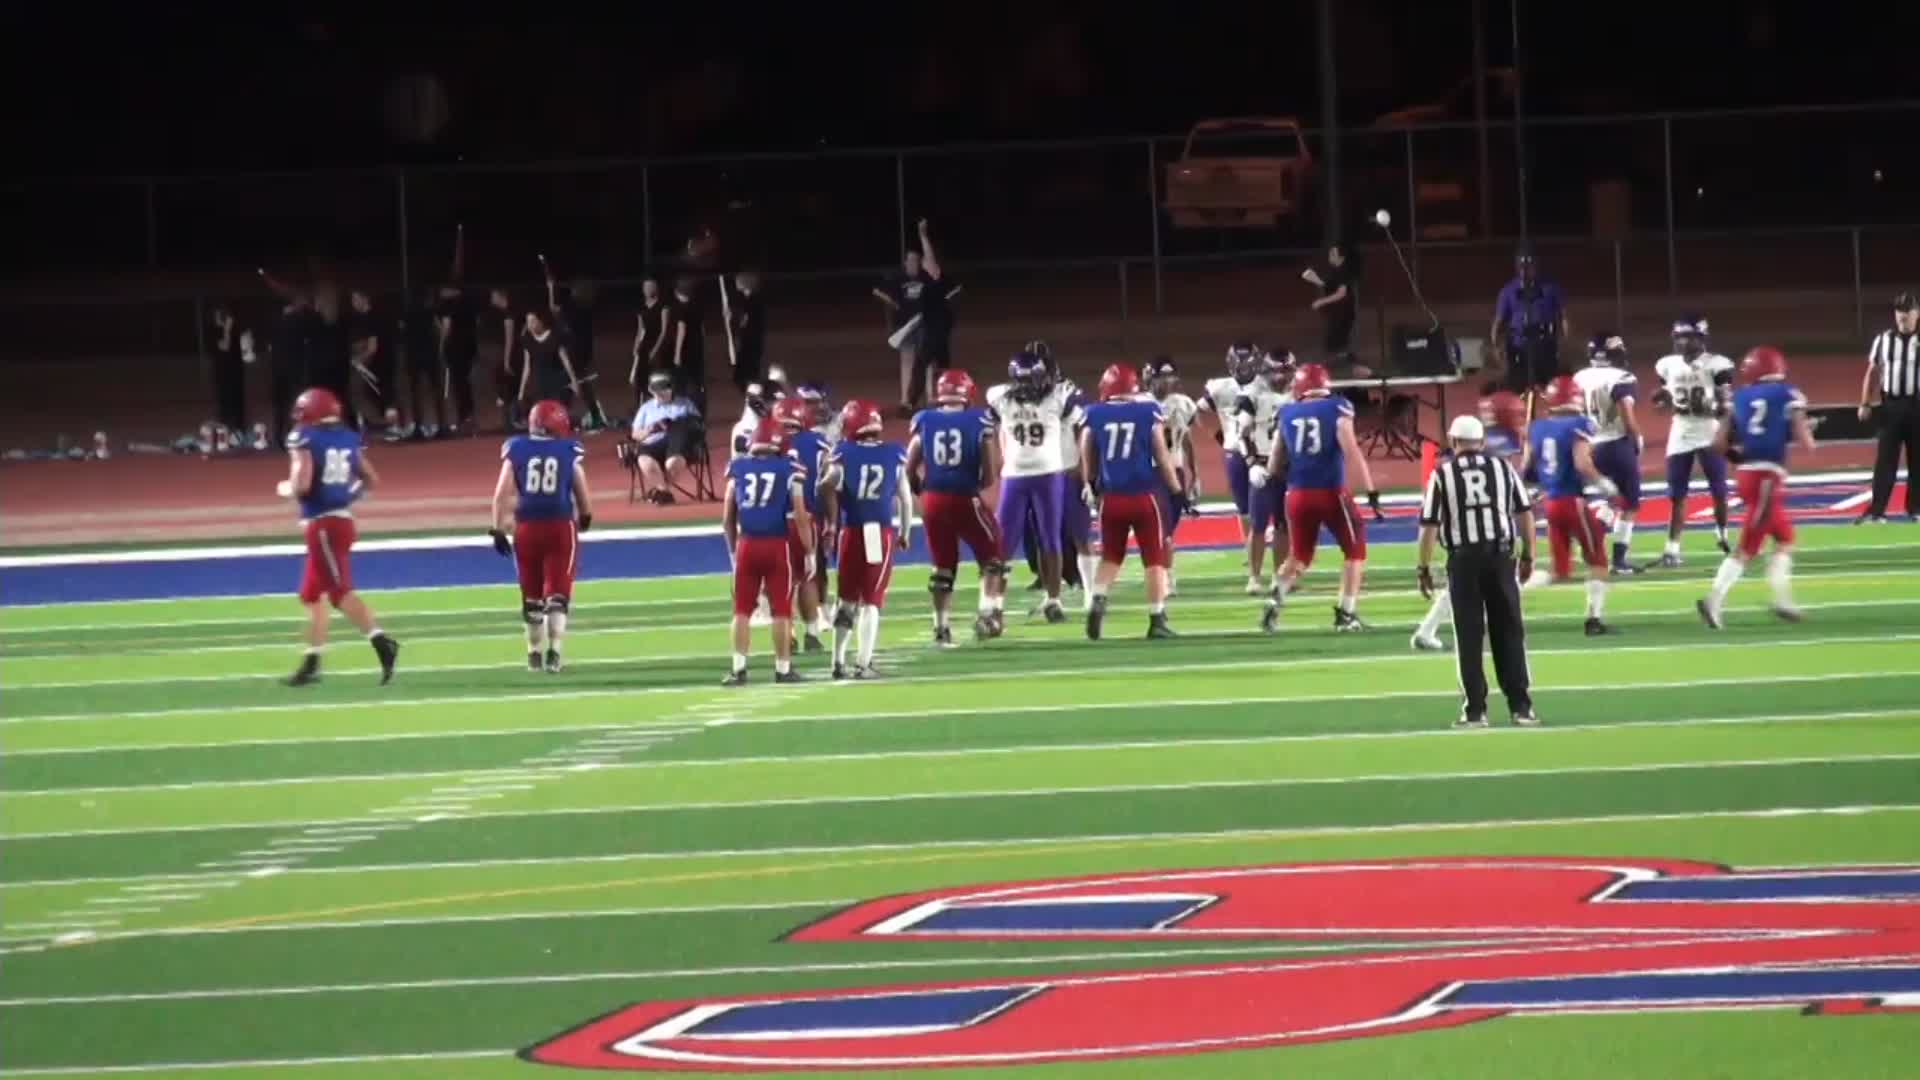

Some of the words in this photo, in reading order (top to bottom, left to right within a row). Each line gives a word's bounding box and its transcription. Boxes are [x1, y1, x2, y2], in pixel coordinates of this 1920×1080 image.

[1013, 422, 1045, 447] 49
[1291, 416, 1322, 455] 73
[1747, 399, 1769, 435] 2
[933, 428, 963, 466] 63
[1104, 421, 1136, 461] 77
[525, 456, 556, 494] 68
[743, 472, 777, 508] 37
[856, 464, 885, 500] 12
[1461, 470, 1491, 507] R
